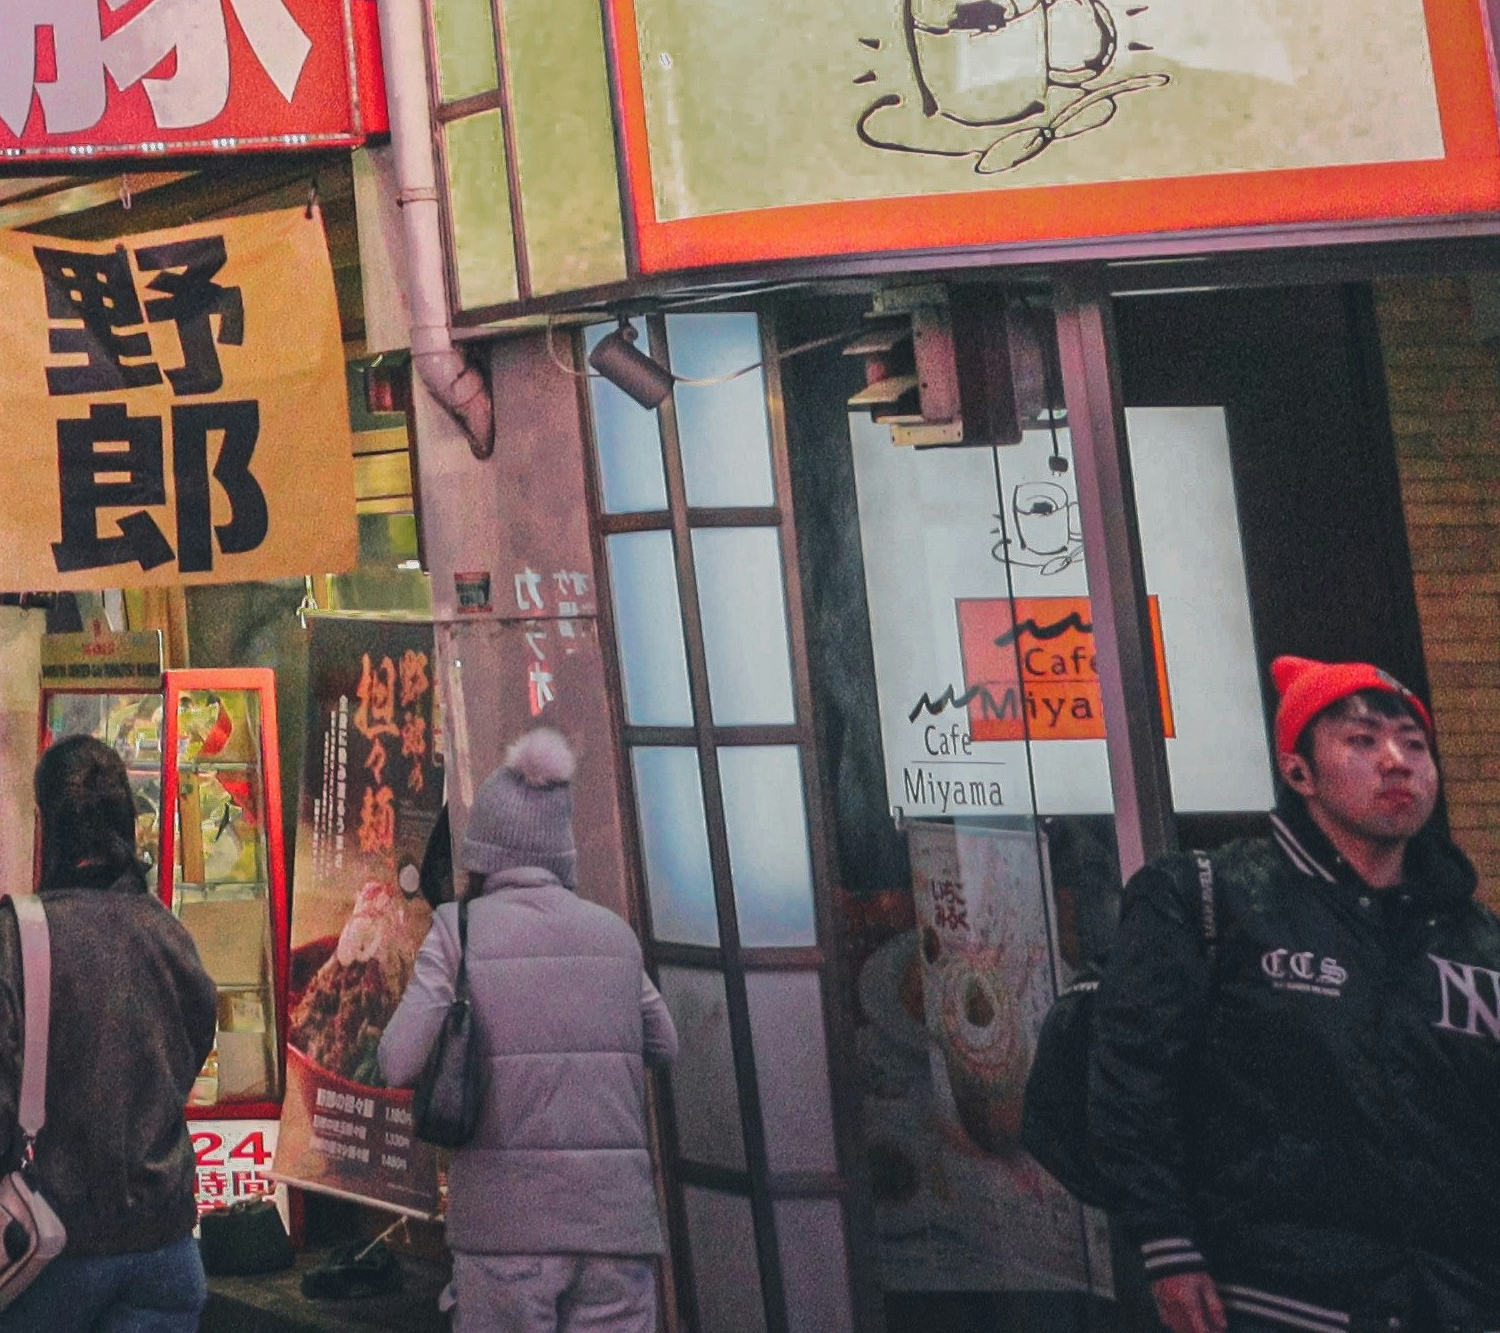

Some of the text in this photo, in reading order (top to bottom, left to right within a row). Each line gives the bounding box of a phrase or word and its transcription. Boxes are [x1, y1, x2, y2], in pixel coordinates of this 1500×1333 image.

[33, 234, 269, 574] 野郎
[979, 688, 1094, 728] Miya
[924, 723, 972, 757] Cafe
[903, 767, 1005, 813] Miyama
[190, 1130, 272, 1167] 24
